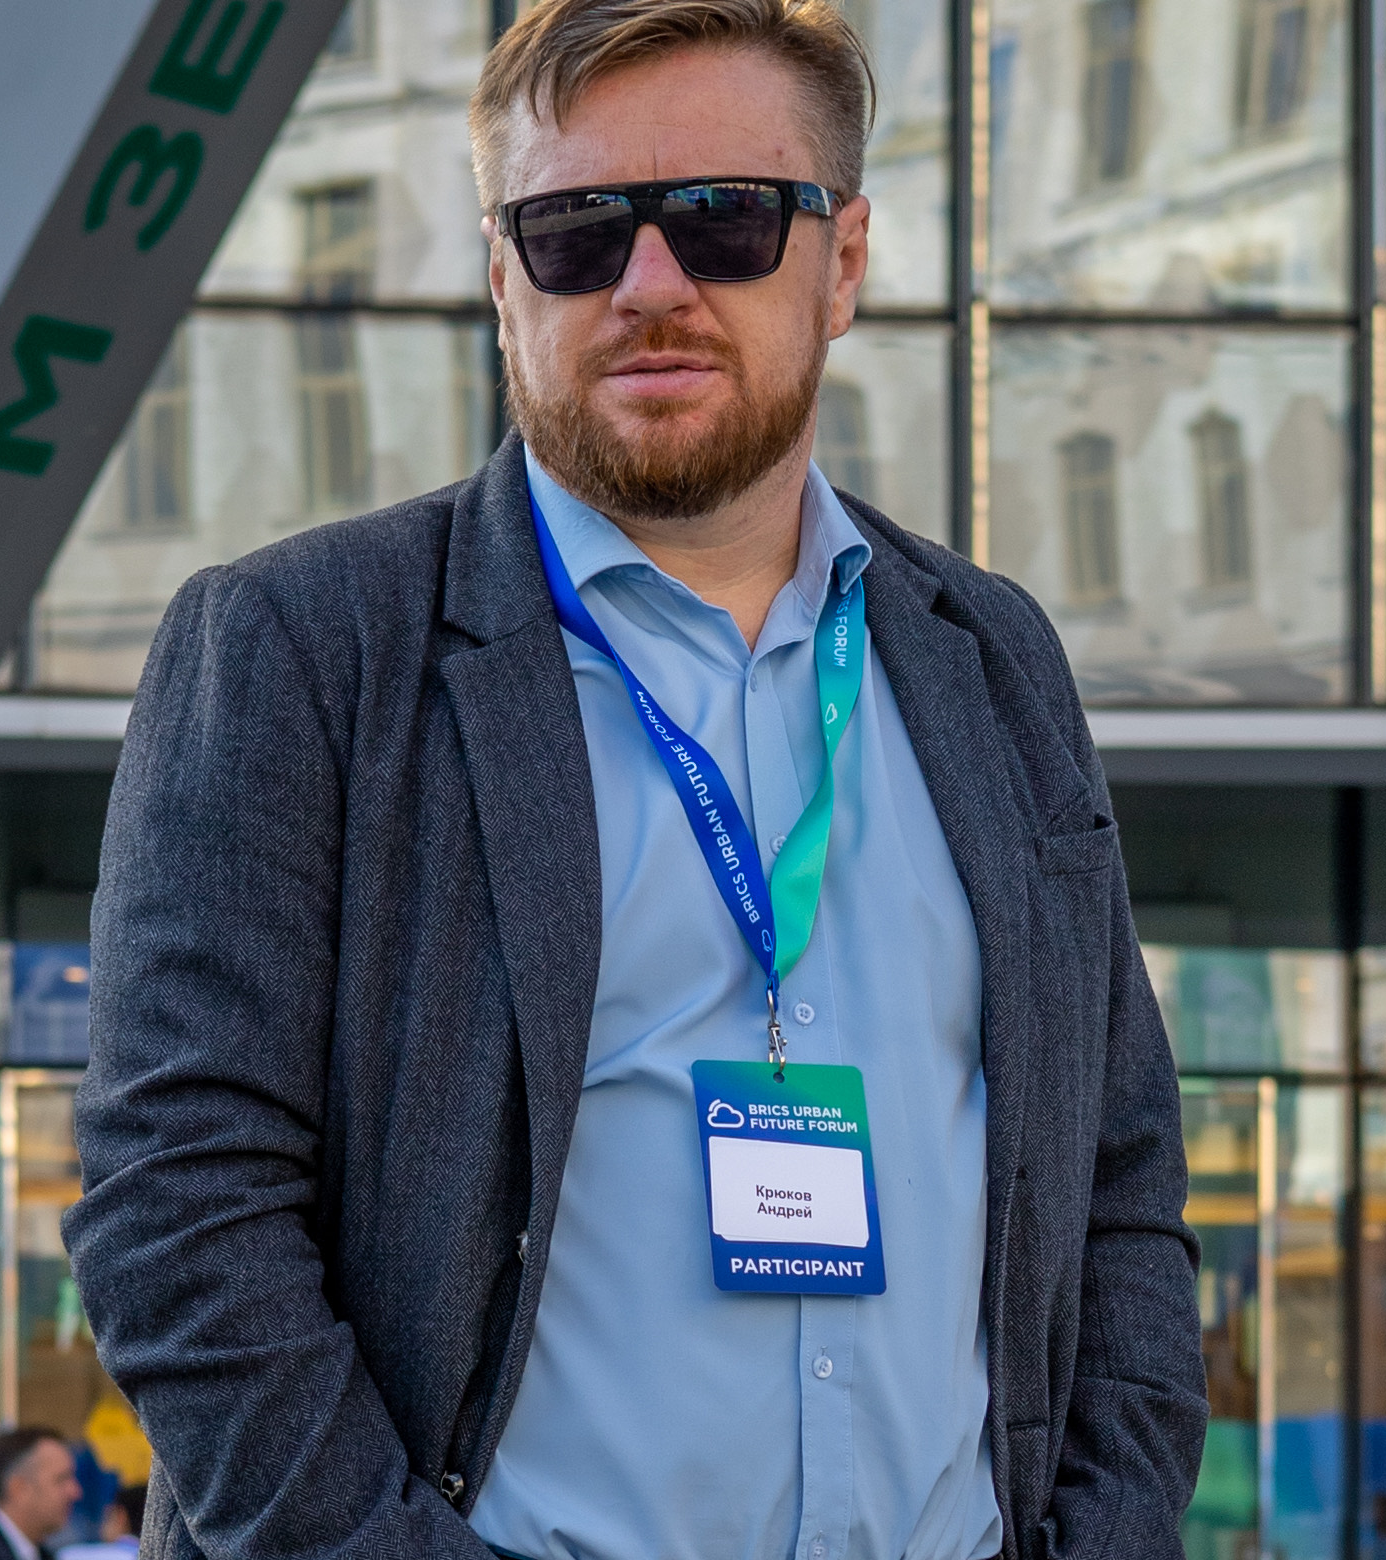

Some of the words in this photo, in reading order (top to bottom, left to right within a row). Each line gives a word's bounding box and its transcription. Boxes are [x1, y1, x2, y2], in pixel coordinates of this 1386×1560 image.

[833, 616, 848, 667] FORUM
[636, 690, 675, 743] FORUM
[670, 743, 714, 807] FUTURE
[705, 808, 740, 871] URBAN
[732, 872, 761, 924] BRICS
[748, 1104, 790, 1116] BRICS
[792, 1105, 842, 1119] URBAN
[750, 1118, 805, 1131] FUTURE
[808, 1120, 858, 1133] FORUM
[755, 1184, 813, 1202] Крюков
[757, 1201, 813, 1219] Андрей
[730, 1257, 865, 1277] PARTICIPANT
